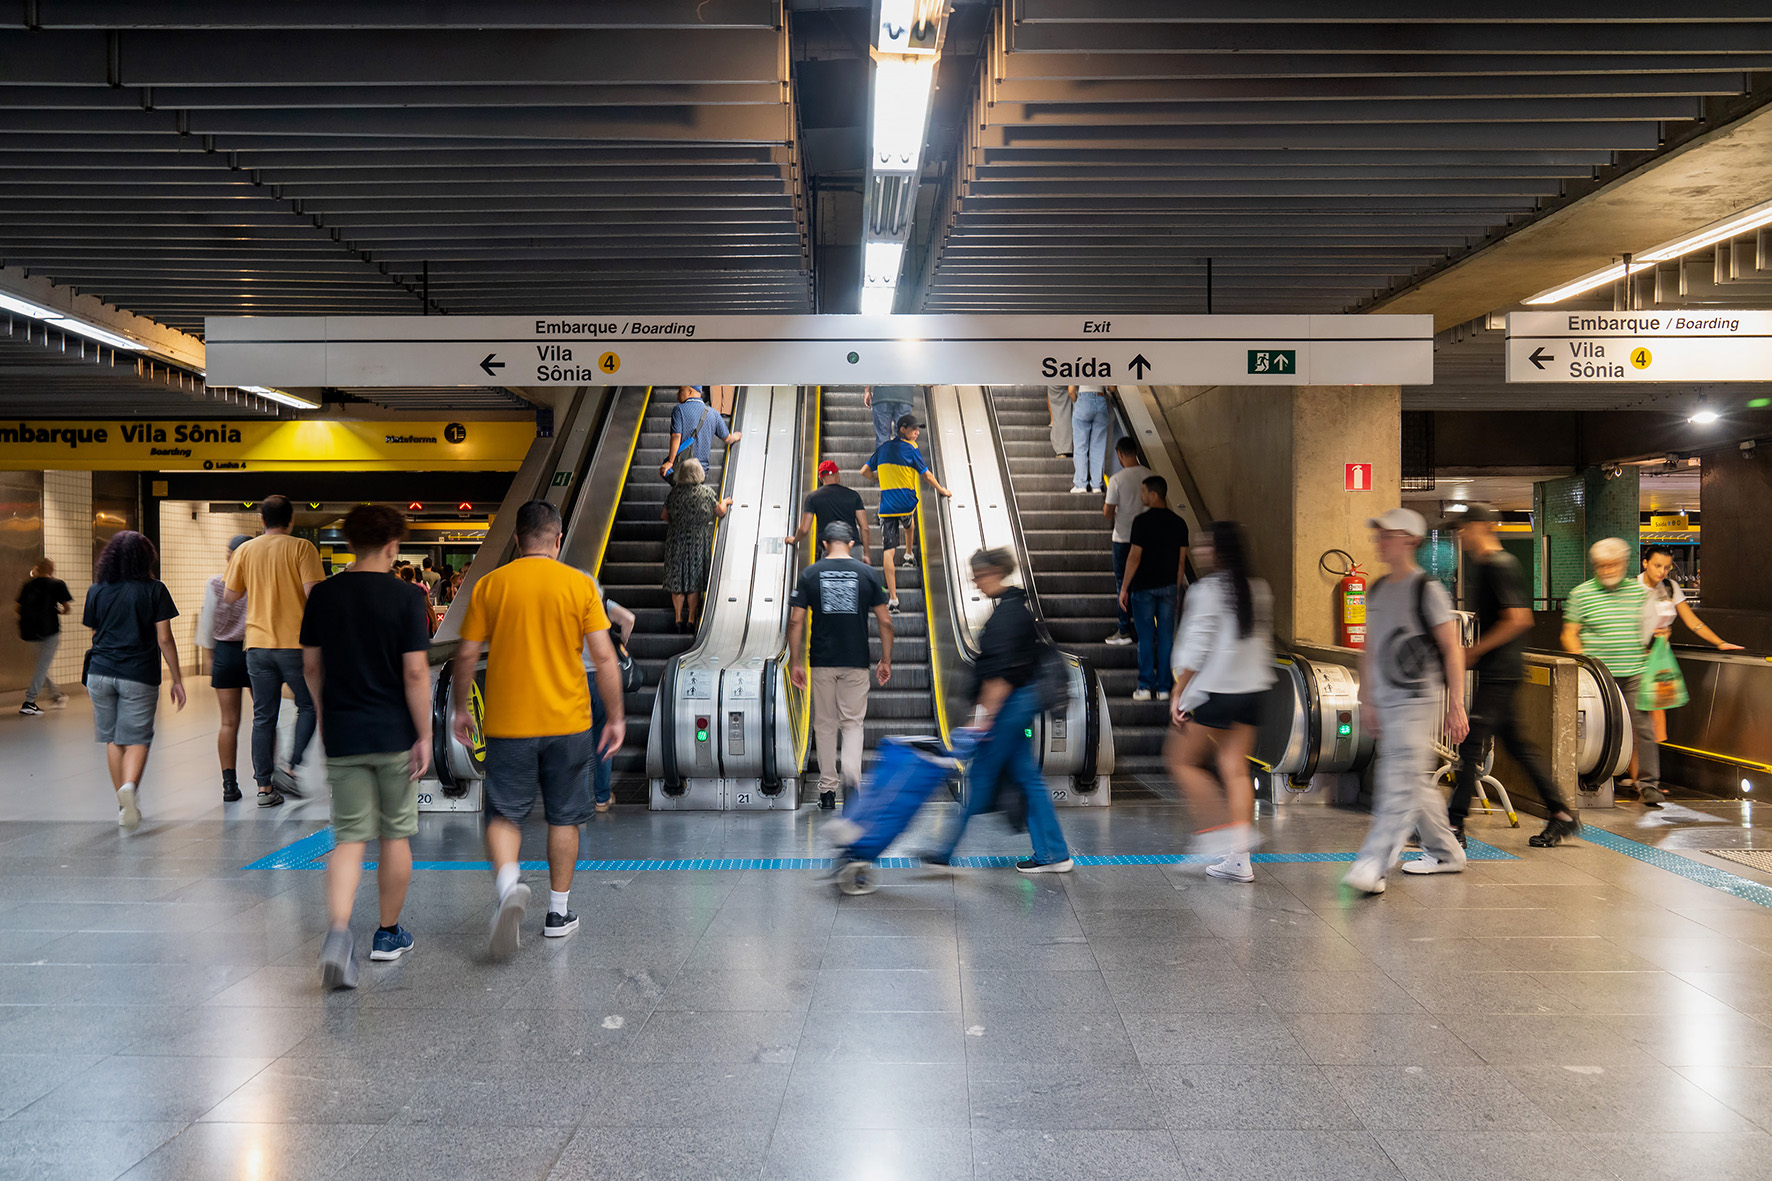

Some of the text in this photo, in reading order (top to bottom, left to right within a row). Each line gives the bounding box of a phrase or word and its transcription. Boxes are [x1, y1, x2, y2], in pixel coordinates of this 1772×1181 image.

[536, 320, 618, 337] Embarque
[631, 322, 696, 337] Boarding
[1083, 320, 1112, 333] Exit
[1568, 315, 1660, 334] Embarque
[1675, 317, 1740, 332] Boarding
[536, 345, 573, 362] Vila
[1569, 341, 1605, 358] Vila
[603, 355, 615, 371] 4
[1042, 356, 1112, 378] Saída
[1635, 350, 1647, 367] 4
[536, 364, 592, 382] Sônia
[1569, 359, 1625, 378] Sônia
[120, 424, 167, 443] Vila
[174, 424, 242, 443] Sônia
[150, 448, 192, 457] Boarding
[417, 793, 432, 804] 20
[738, 794, 749, 804] 21
[1053, 790, 1066, 800] 22
